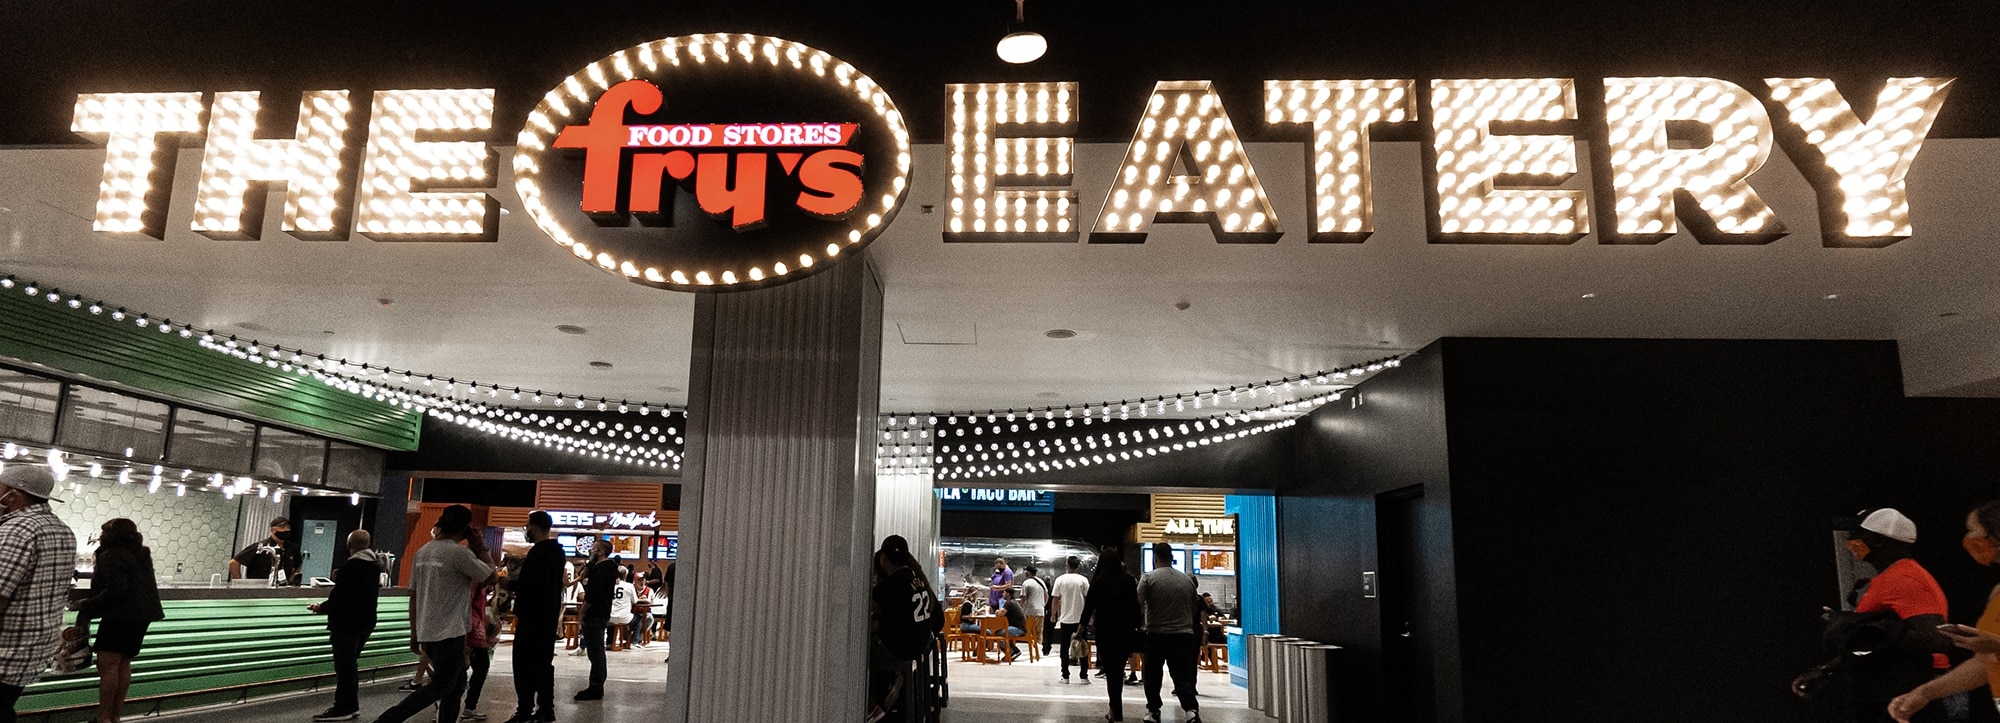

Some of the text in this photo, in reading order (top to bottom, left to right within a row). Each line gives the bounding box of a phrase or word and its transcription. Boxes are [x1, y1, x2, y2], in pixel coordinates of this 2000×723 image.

[70, 89, 498, 236] THE
[552, 79, 865, 229] fry's
[627, 123, 842, 147] FOOD STORES
[942, 77, 1957, 240] EATERY
[1164, 517, 1234, 535] ALL THE
[911, 590, 931, 623] 22
